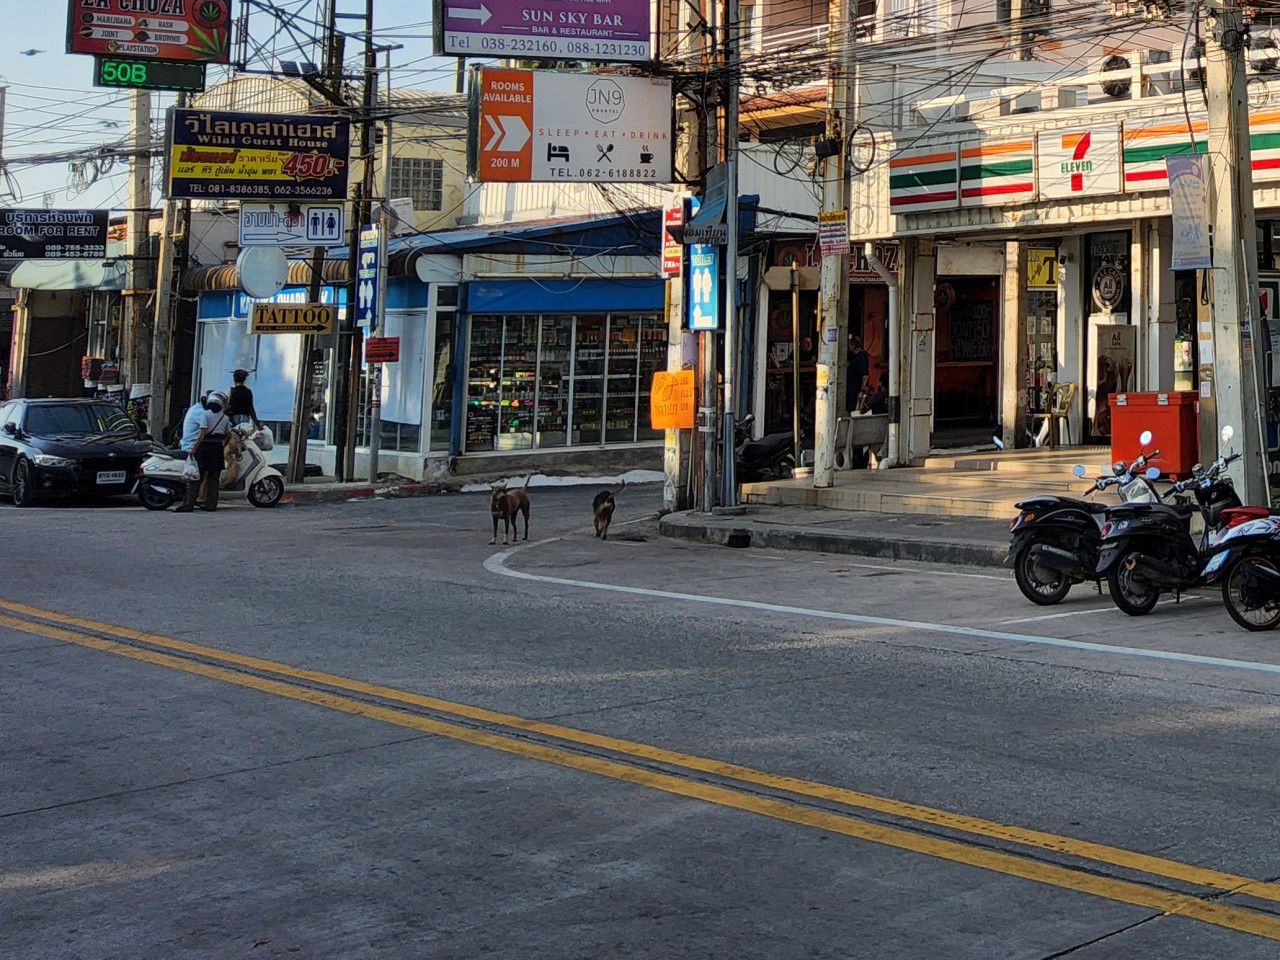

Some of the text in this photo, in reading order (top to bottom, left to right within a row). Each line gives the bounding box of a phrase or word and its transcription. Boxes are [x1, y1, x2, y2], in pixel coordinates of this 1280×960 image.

[522, 10, 623, 27] SUN SKY BAR
[532, 26, 549, 34] BAR
[560, 27, 613, 36] RESTAURANT
[449, 35, 646, 57] Tel 038-232160, 088-1231230
[491, 81, 525, 91] ROOMS
[483, 93, 532, 103] AVAILABLE
[589, 89, 621, 105] JN9
[539, 128, 667, 139] SLEEP EAT DRINK
[197, 134, 328, 148] Wilai Guest House
[491, 158, 520, 167] 200 M
[1061, 131, 1091, 191] 7
[275, 186, 333, 195] 062-3566236
[5, 210, 94, 223] บริการห้องพัก
[0, 225, 100, 236] ROOM FOR RENT
[692, 253, 714, 265] TOILET
[256, 308, 330, 324] TATTOO
